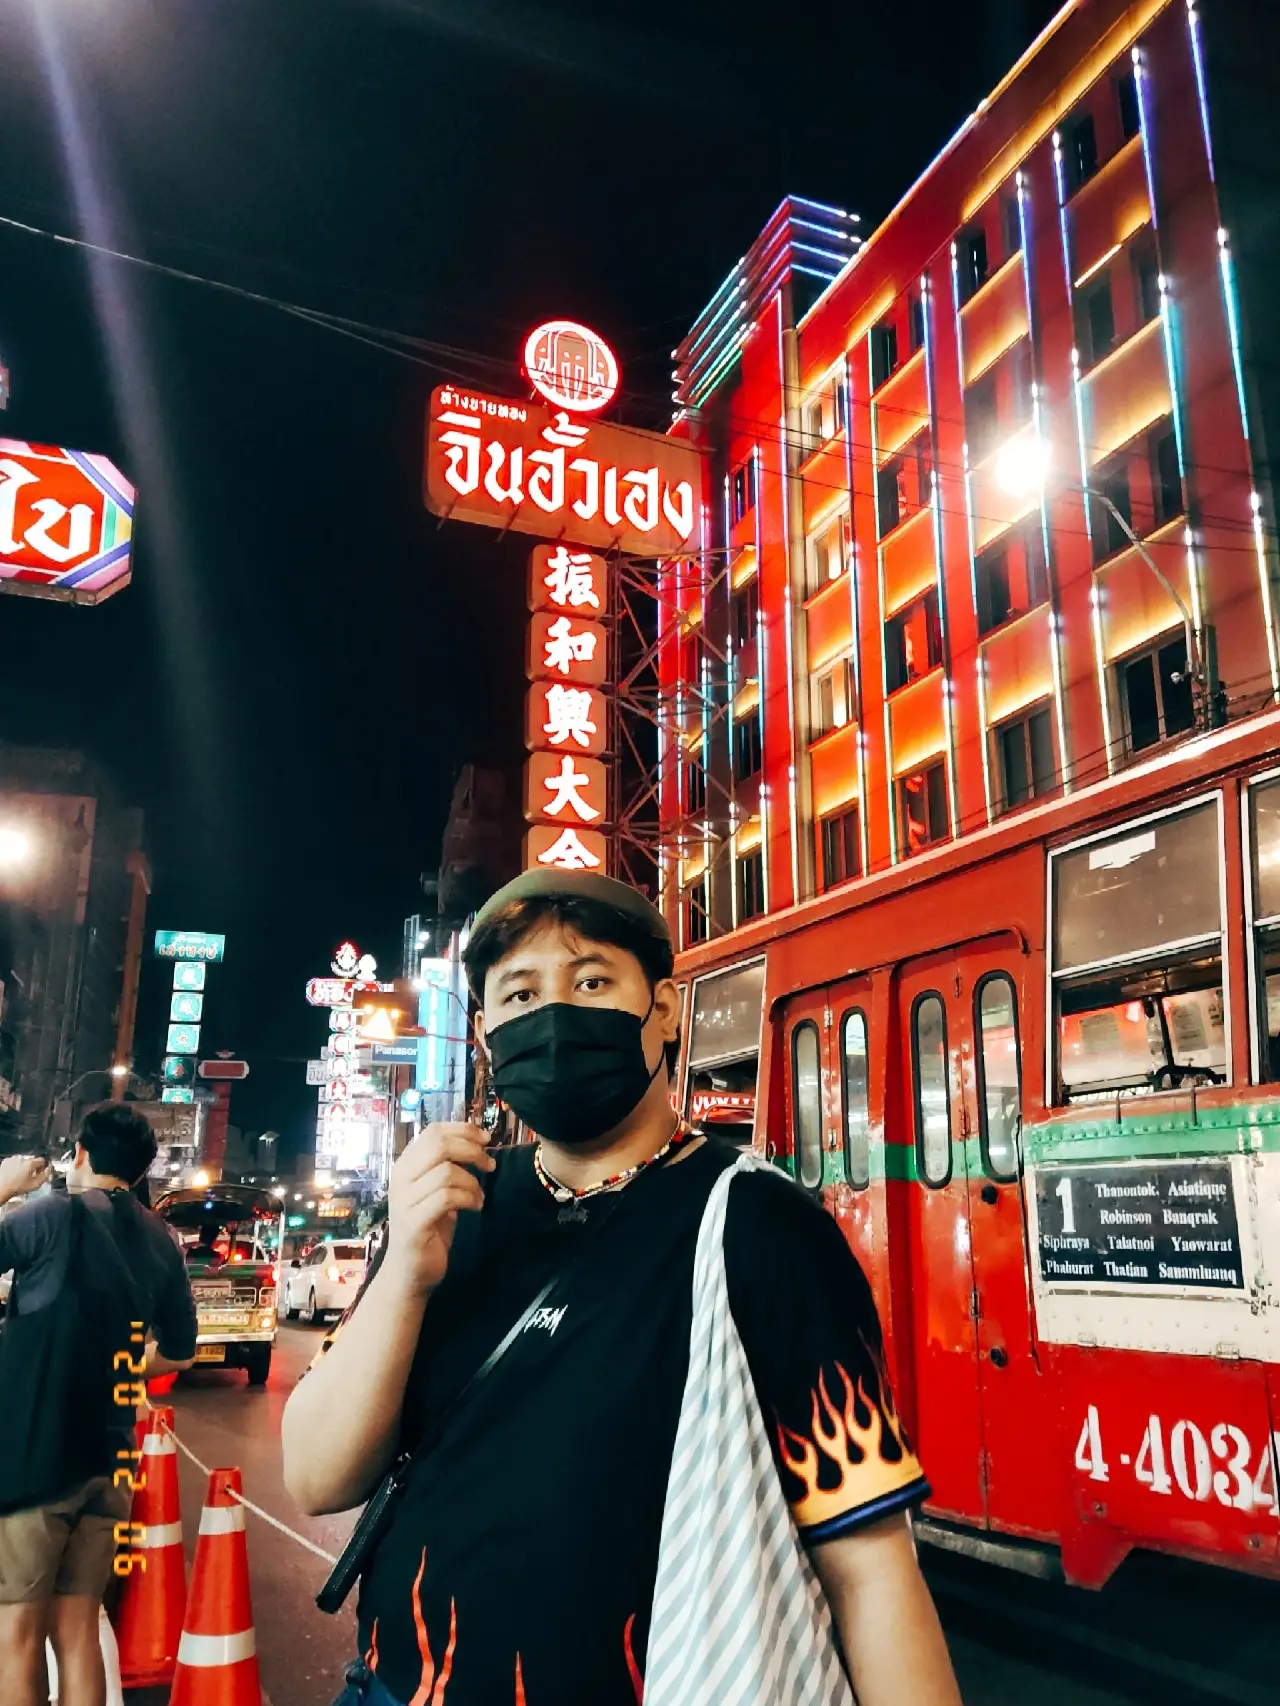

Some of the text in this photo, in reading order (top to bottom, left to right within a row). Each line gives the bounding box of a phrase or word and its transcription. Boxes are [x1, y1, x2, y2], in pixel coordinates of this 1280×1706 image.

[1167, 1180, 1227, 1200] Asiatique
[1055, 1177, 1077, 1233] 1
[1100, 1208, 1152, 1225] Robinson
[1106, 1235, 1155, 1252] Talatnoi
[1170, 1236, 1233, 1252] Yaowarat
